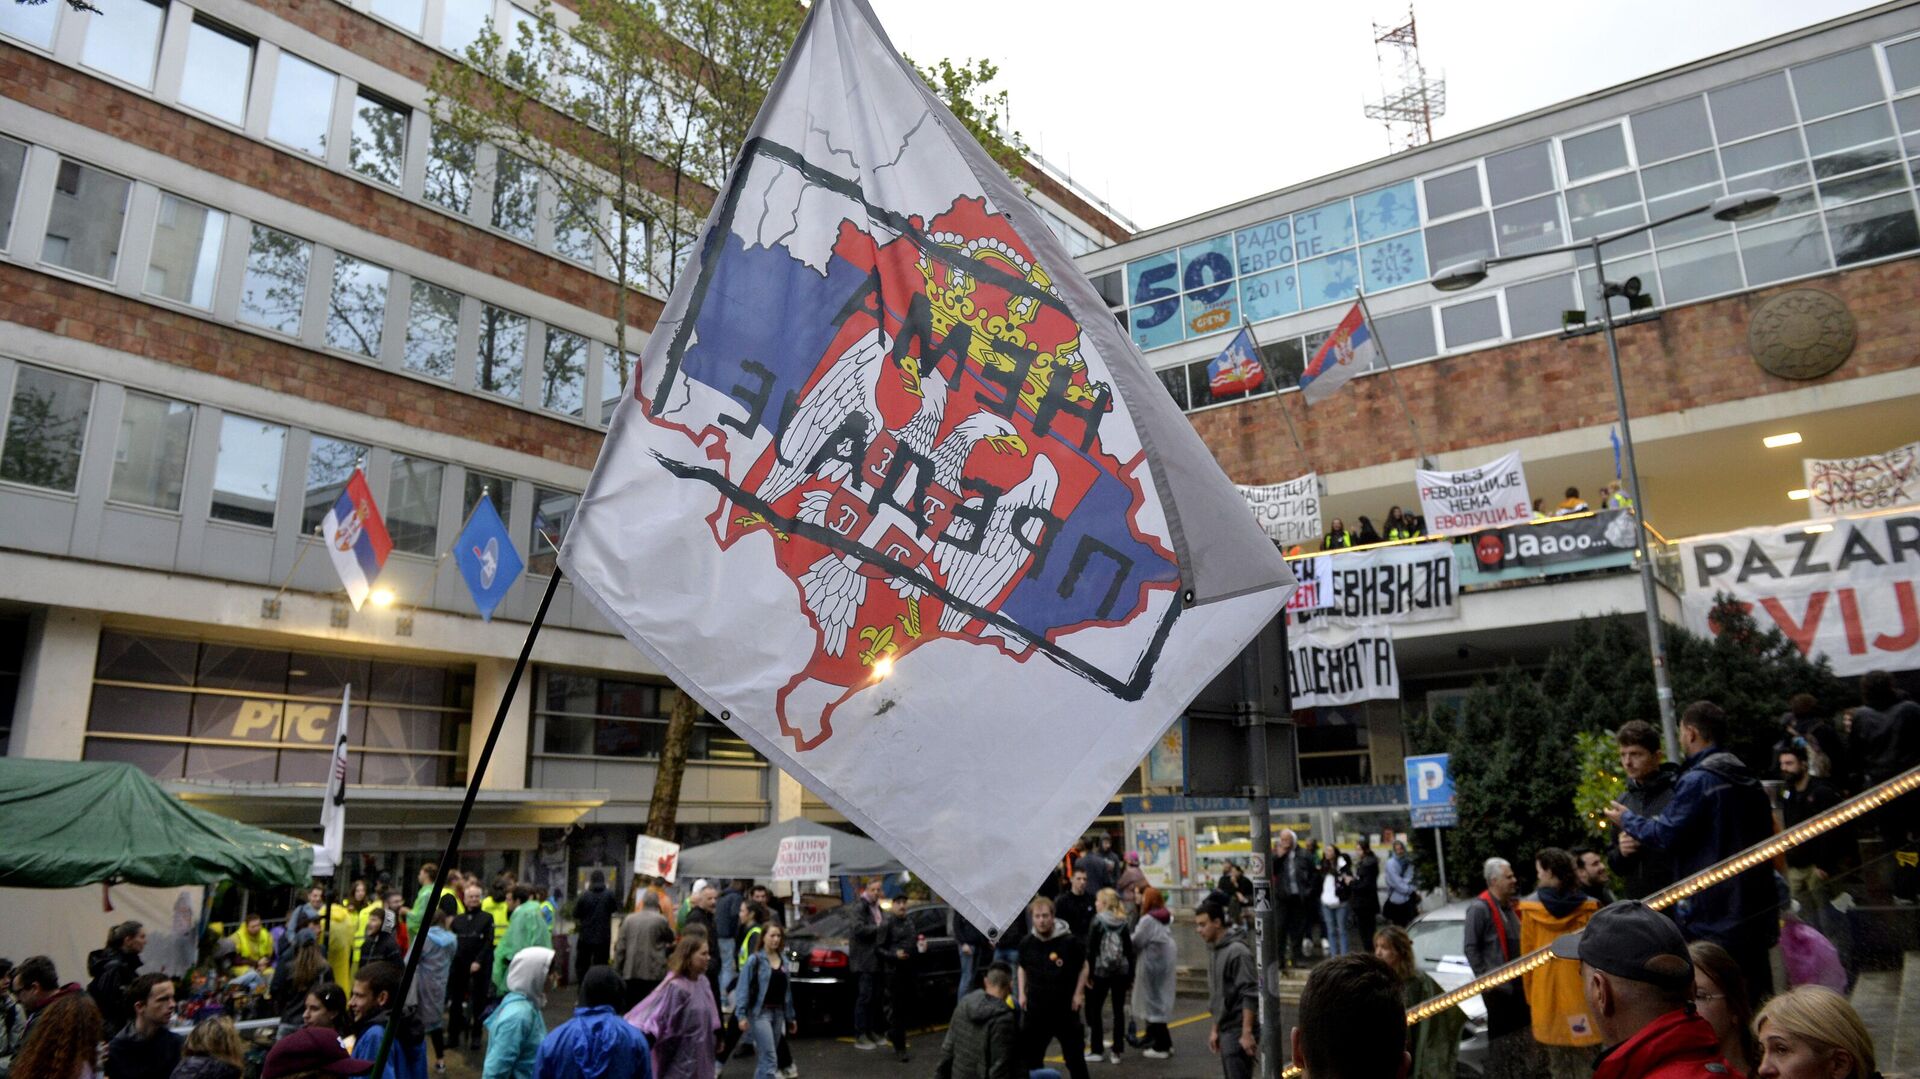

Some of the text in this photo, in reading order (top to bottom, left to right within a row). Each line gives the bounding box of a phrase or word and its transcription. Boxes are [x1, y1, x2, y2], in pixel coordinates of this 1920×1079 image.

[1236, 212, 1321, 249] РАДОСТ
[1239, 236, 1323, 276] ЕВРОПЕ
[1134, 252, 1232, 329] 50
[1246, 275, 1296, 302] 2019
[1422, 471, 1520, 500] РЕВОЛУЦИЈЕ
[1451, 469, 1483, 485] БЕЗ
[1435, 502, 1528, 529] ЕВОЛУЦИЈЕ
[1449, 495, 1492, 513] НЕМА
[1694, 516, 1920, 587] PAZAR
